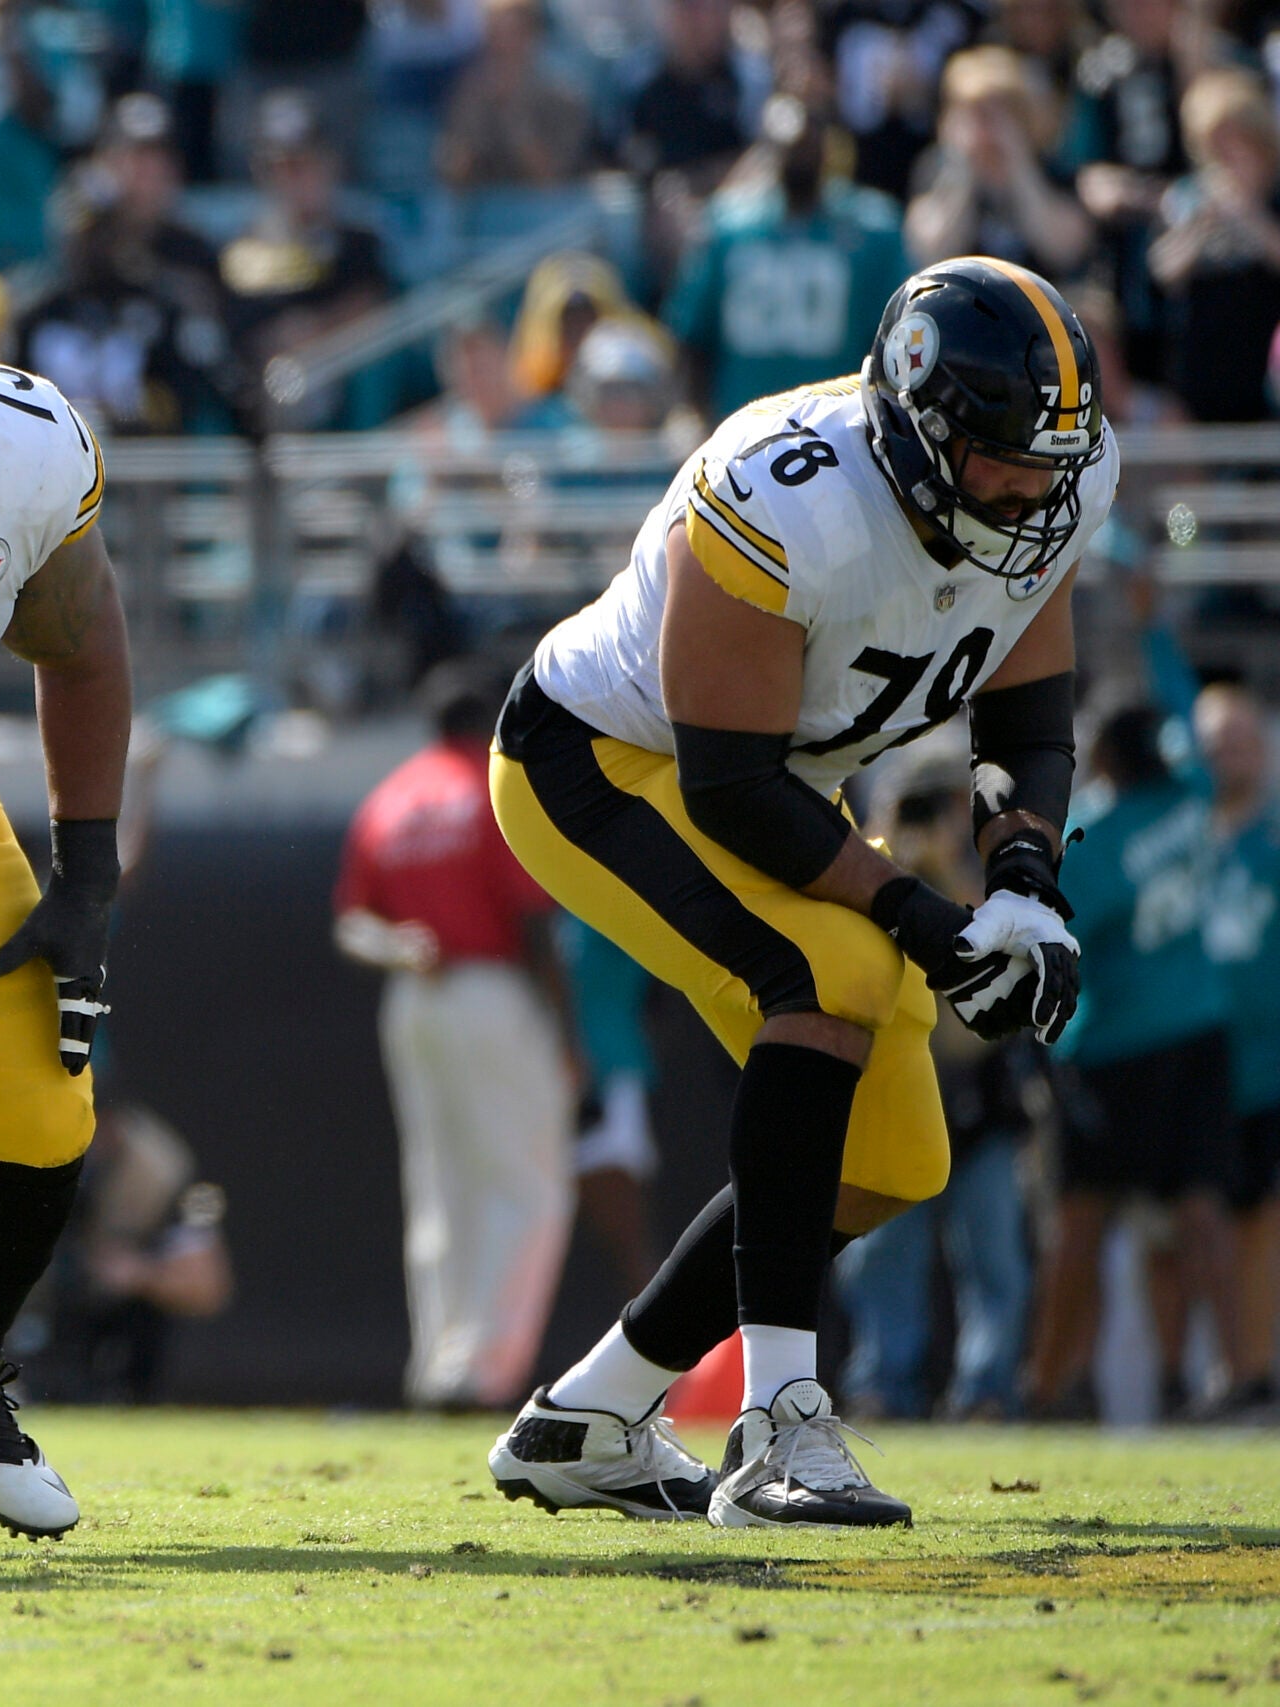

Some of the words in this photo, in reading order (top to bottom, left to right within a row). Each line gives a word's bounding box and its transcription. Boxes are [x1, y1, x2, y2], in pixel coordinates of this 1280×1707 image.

[1034, 382, 1092, 431] 78
[734, 418, 840, 487] 78
[1050, 434, 1081, 446] Steelers
